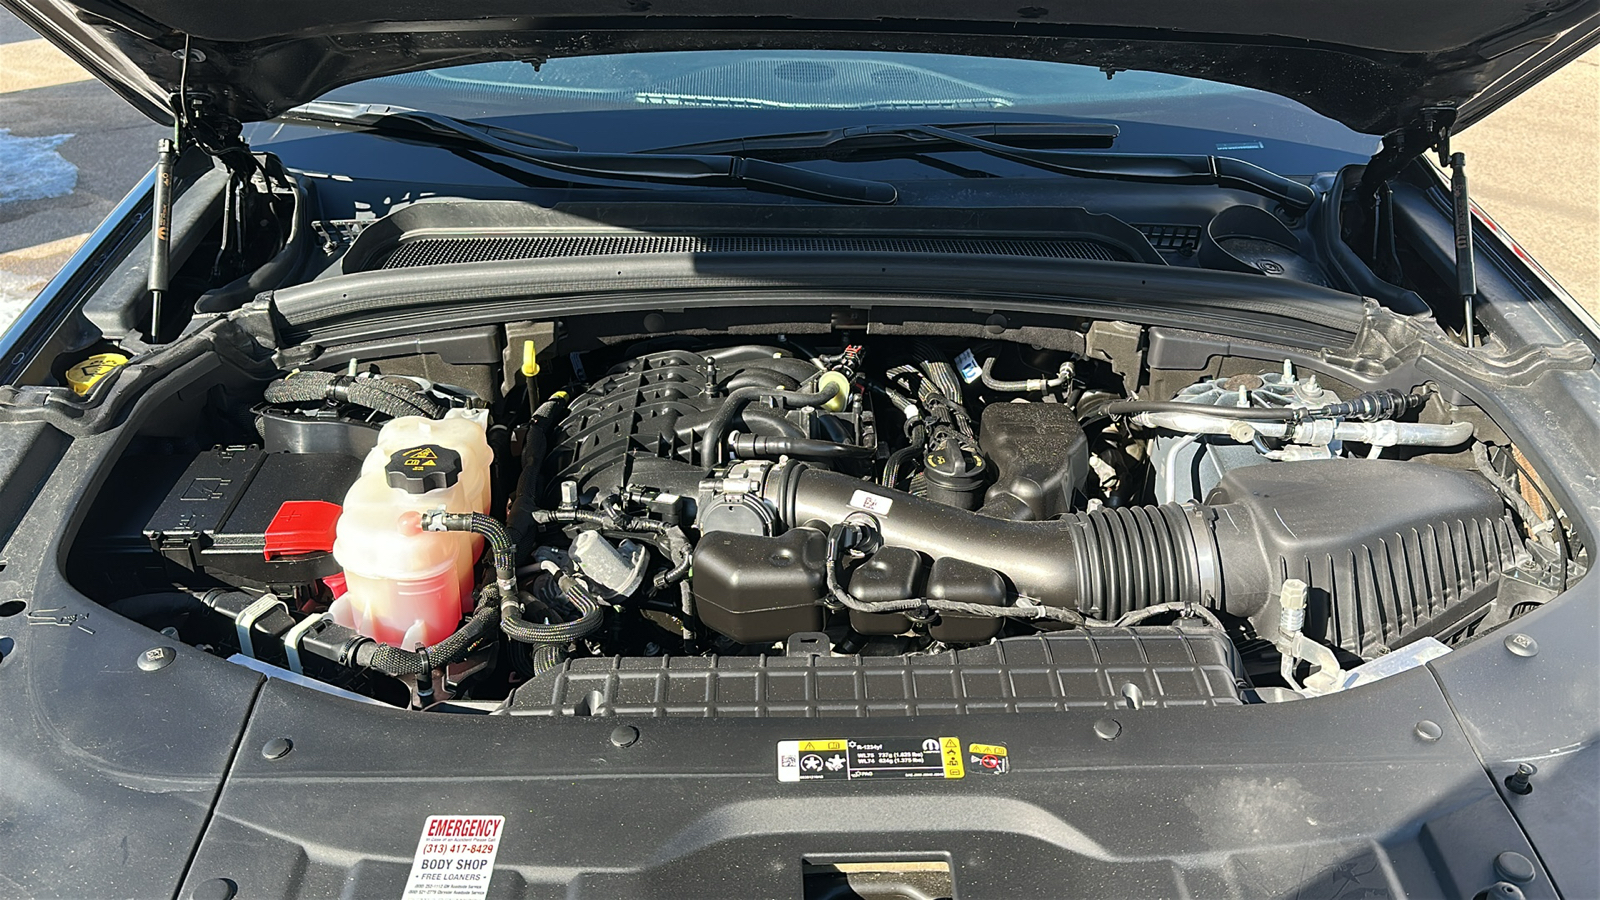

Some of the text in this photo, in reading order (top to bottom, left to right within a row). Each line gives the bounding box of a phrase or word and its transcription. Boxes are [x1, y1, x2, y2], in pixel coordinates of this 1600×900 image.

[428, 819, 502, 837] EMERGENCY
[423, 844, 494, 855] (313) 417-8429
[421, 859, 488, 870] BODY SHOP
